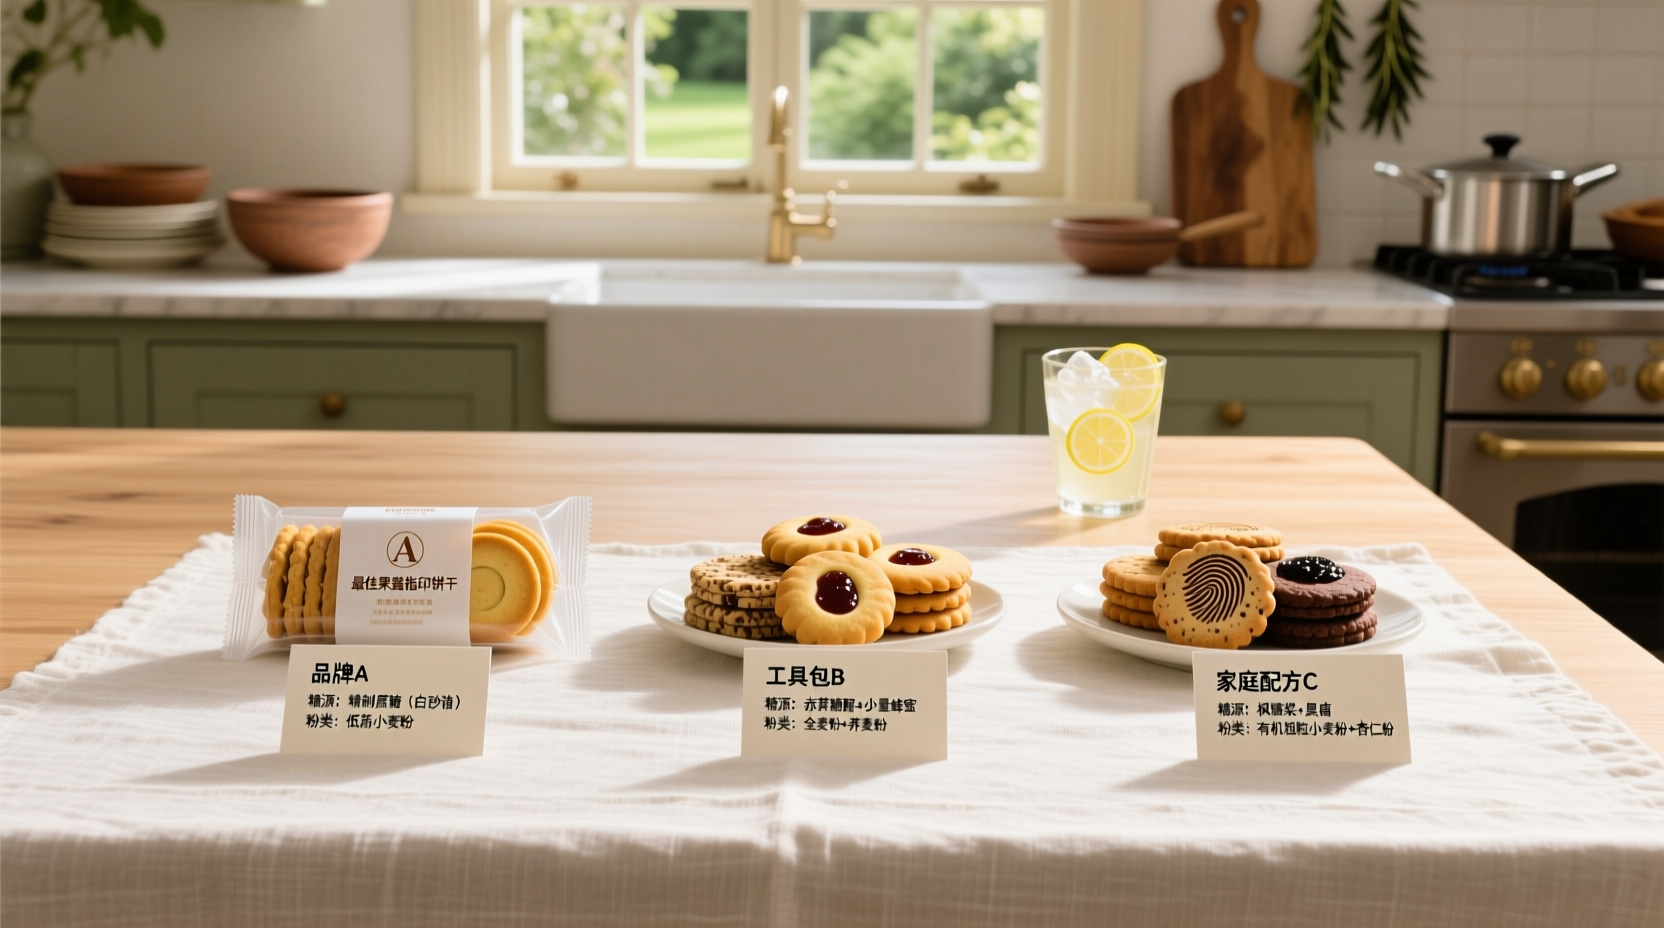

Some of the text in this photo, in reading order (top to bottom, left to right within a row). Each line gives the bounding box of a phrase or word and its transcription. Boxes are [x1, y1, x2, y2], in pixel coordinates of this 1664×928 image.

[392, 536, 417, 562] A
[312, 663, 368, 685] 品牌A
[766, 665, 845, 687] 工具包B
[1217, 670, 1318, 691] 家庭配方C
